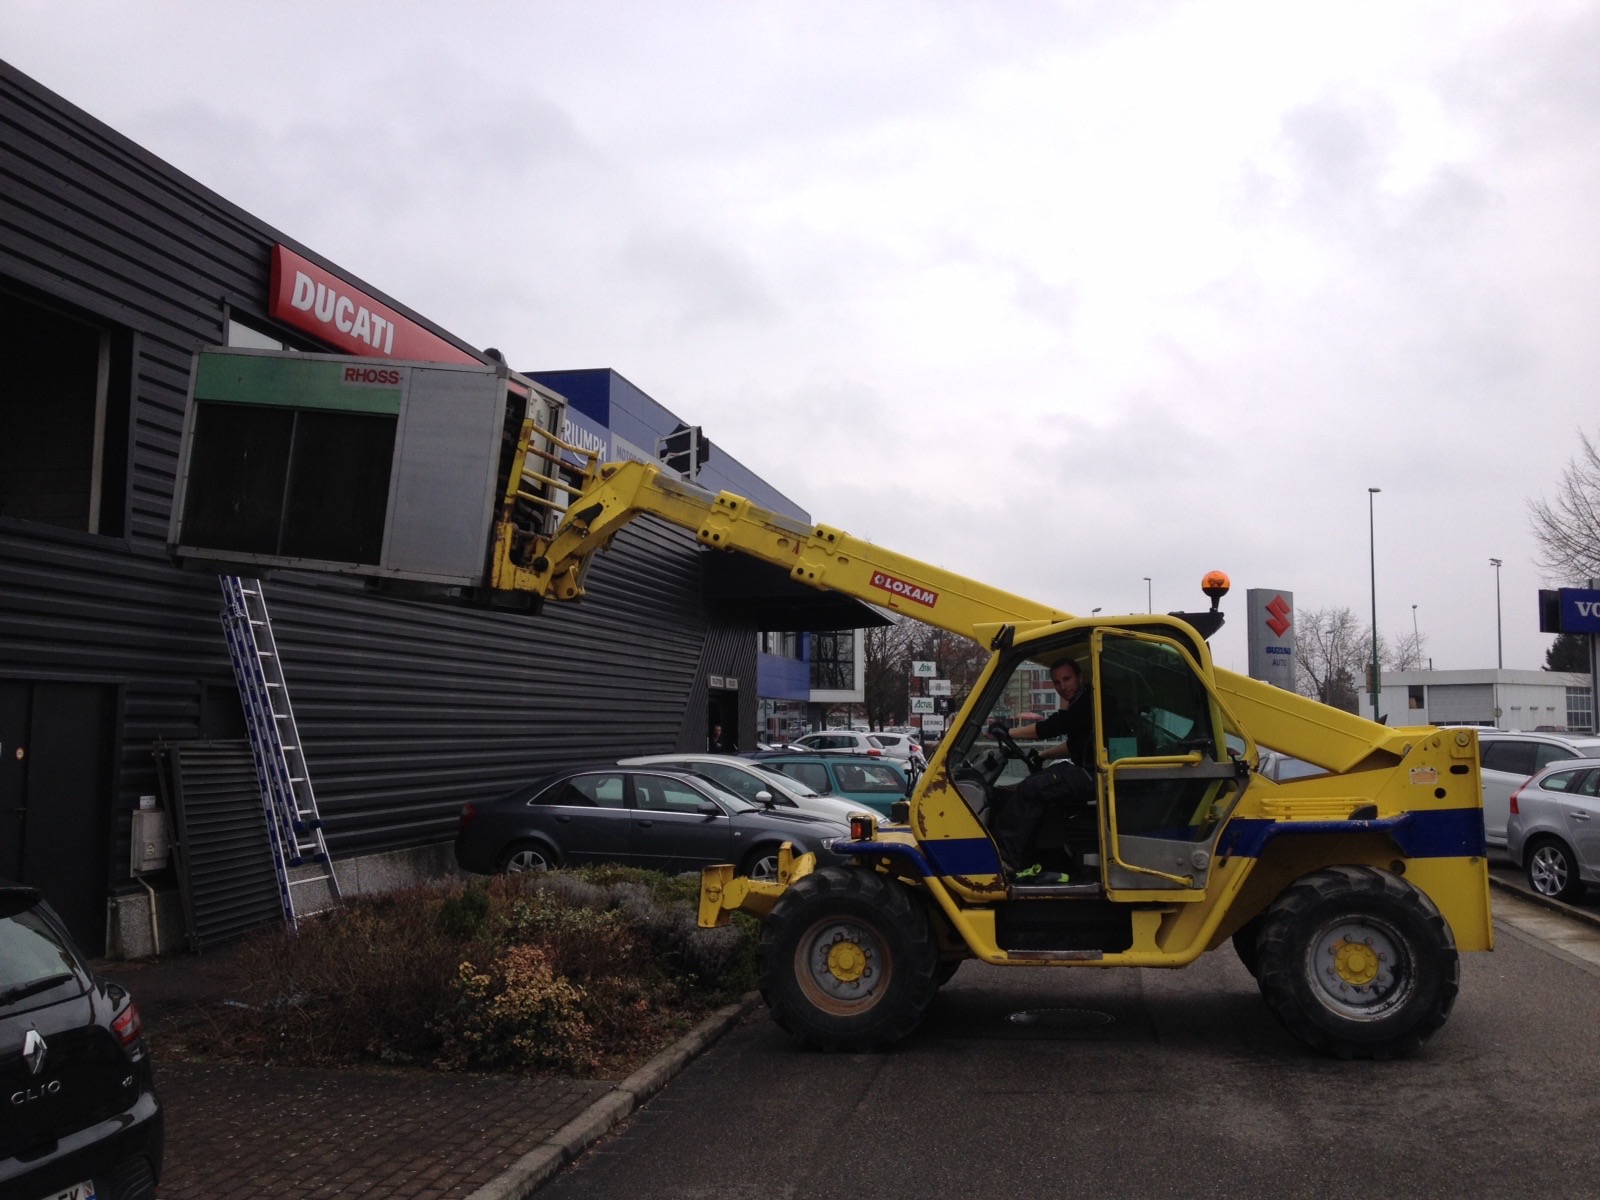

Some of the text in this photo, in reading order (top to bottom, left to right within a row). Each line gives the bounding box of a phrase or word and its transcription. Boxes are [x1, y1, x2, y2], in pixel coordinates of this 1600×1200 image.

[291, 271, 394, 355] DUCATI
[344, 367, 400, 385] RHOSS
[562, 418, 607, 463] RIUMPH
[884, 577, 935, 604] LOXAM
[1266, 646, 1291, 655] SUZUKI
[1272, 658, 1288, 667] AUTO
[11, 1080, 61, 1105] CLIO
